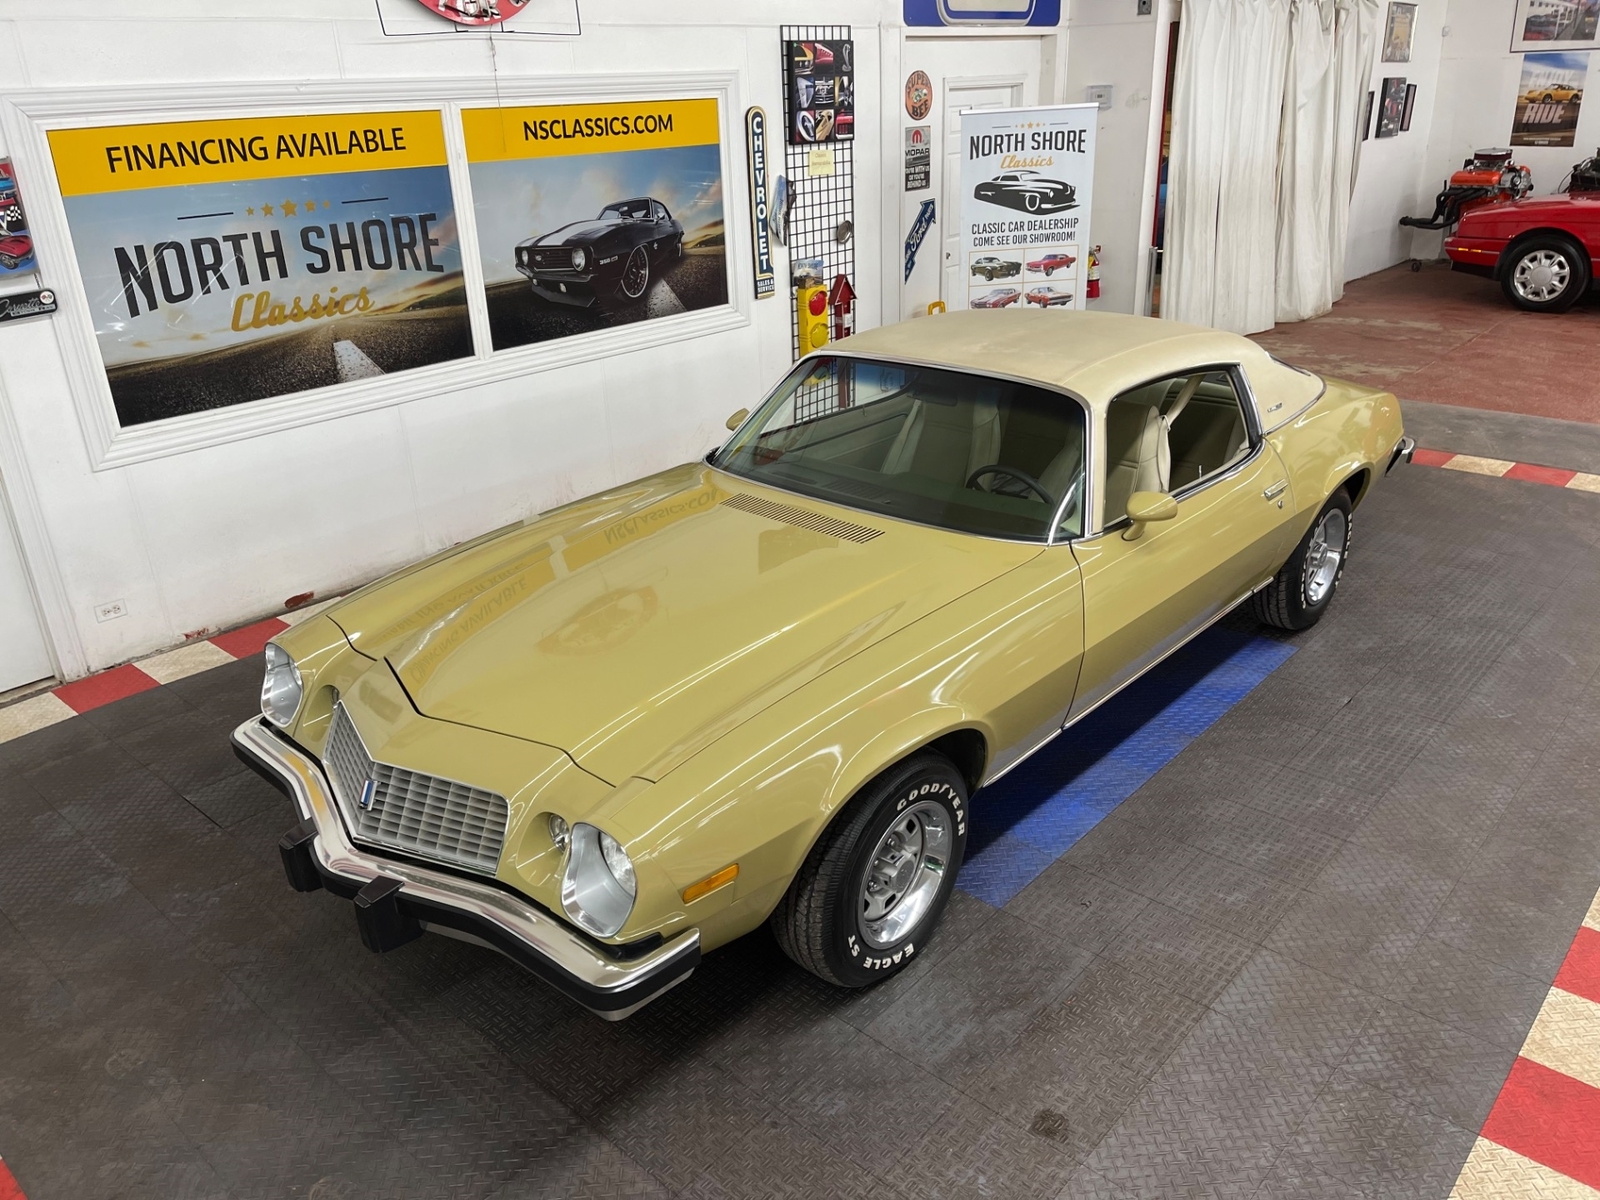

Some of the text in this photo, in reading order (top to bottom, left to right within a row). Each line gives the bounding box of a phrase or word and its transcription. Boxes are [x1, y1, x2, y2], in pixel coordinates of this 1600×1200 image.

[911, 99, 928, 117] BEE
[1522, 103, 1565, 124] RIDE
[523, 113, 674, 141] NSCLASSICS.COM
[105, 127, 407, 173] FINANCING AVAILABLE
[905, 147, 930, 157] MOPAR
[970, 129, 1087, 160] NORTH SHORE
[1000, 155, 1054, 169] Classics
[753, 117, 768, 270] CHEVROLET
[971, 217, 1079, 235] CLASSIC CAR DEALERSHIP
[973, 231, 1076, 247] COME SEE OUR SHOWROOM!
[113, 213, 444, 319] NORTH SHORE
[230, 286, 376, 332] Classics
[896, 782, 965, 836] GOODYEAR
[847, 934, 915, 970] EAGLE ST
